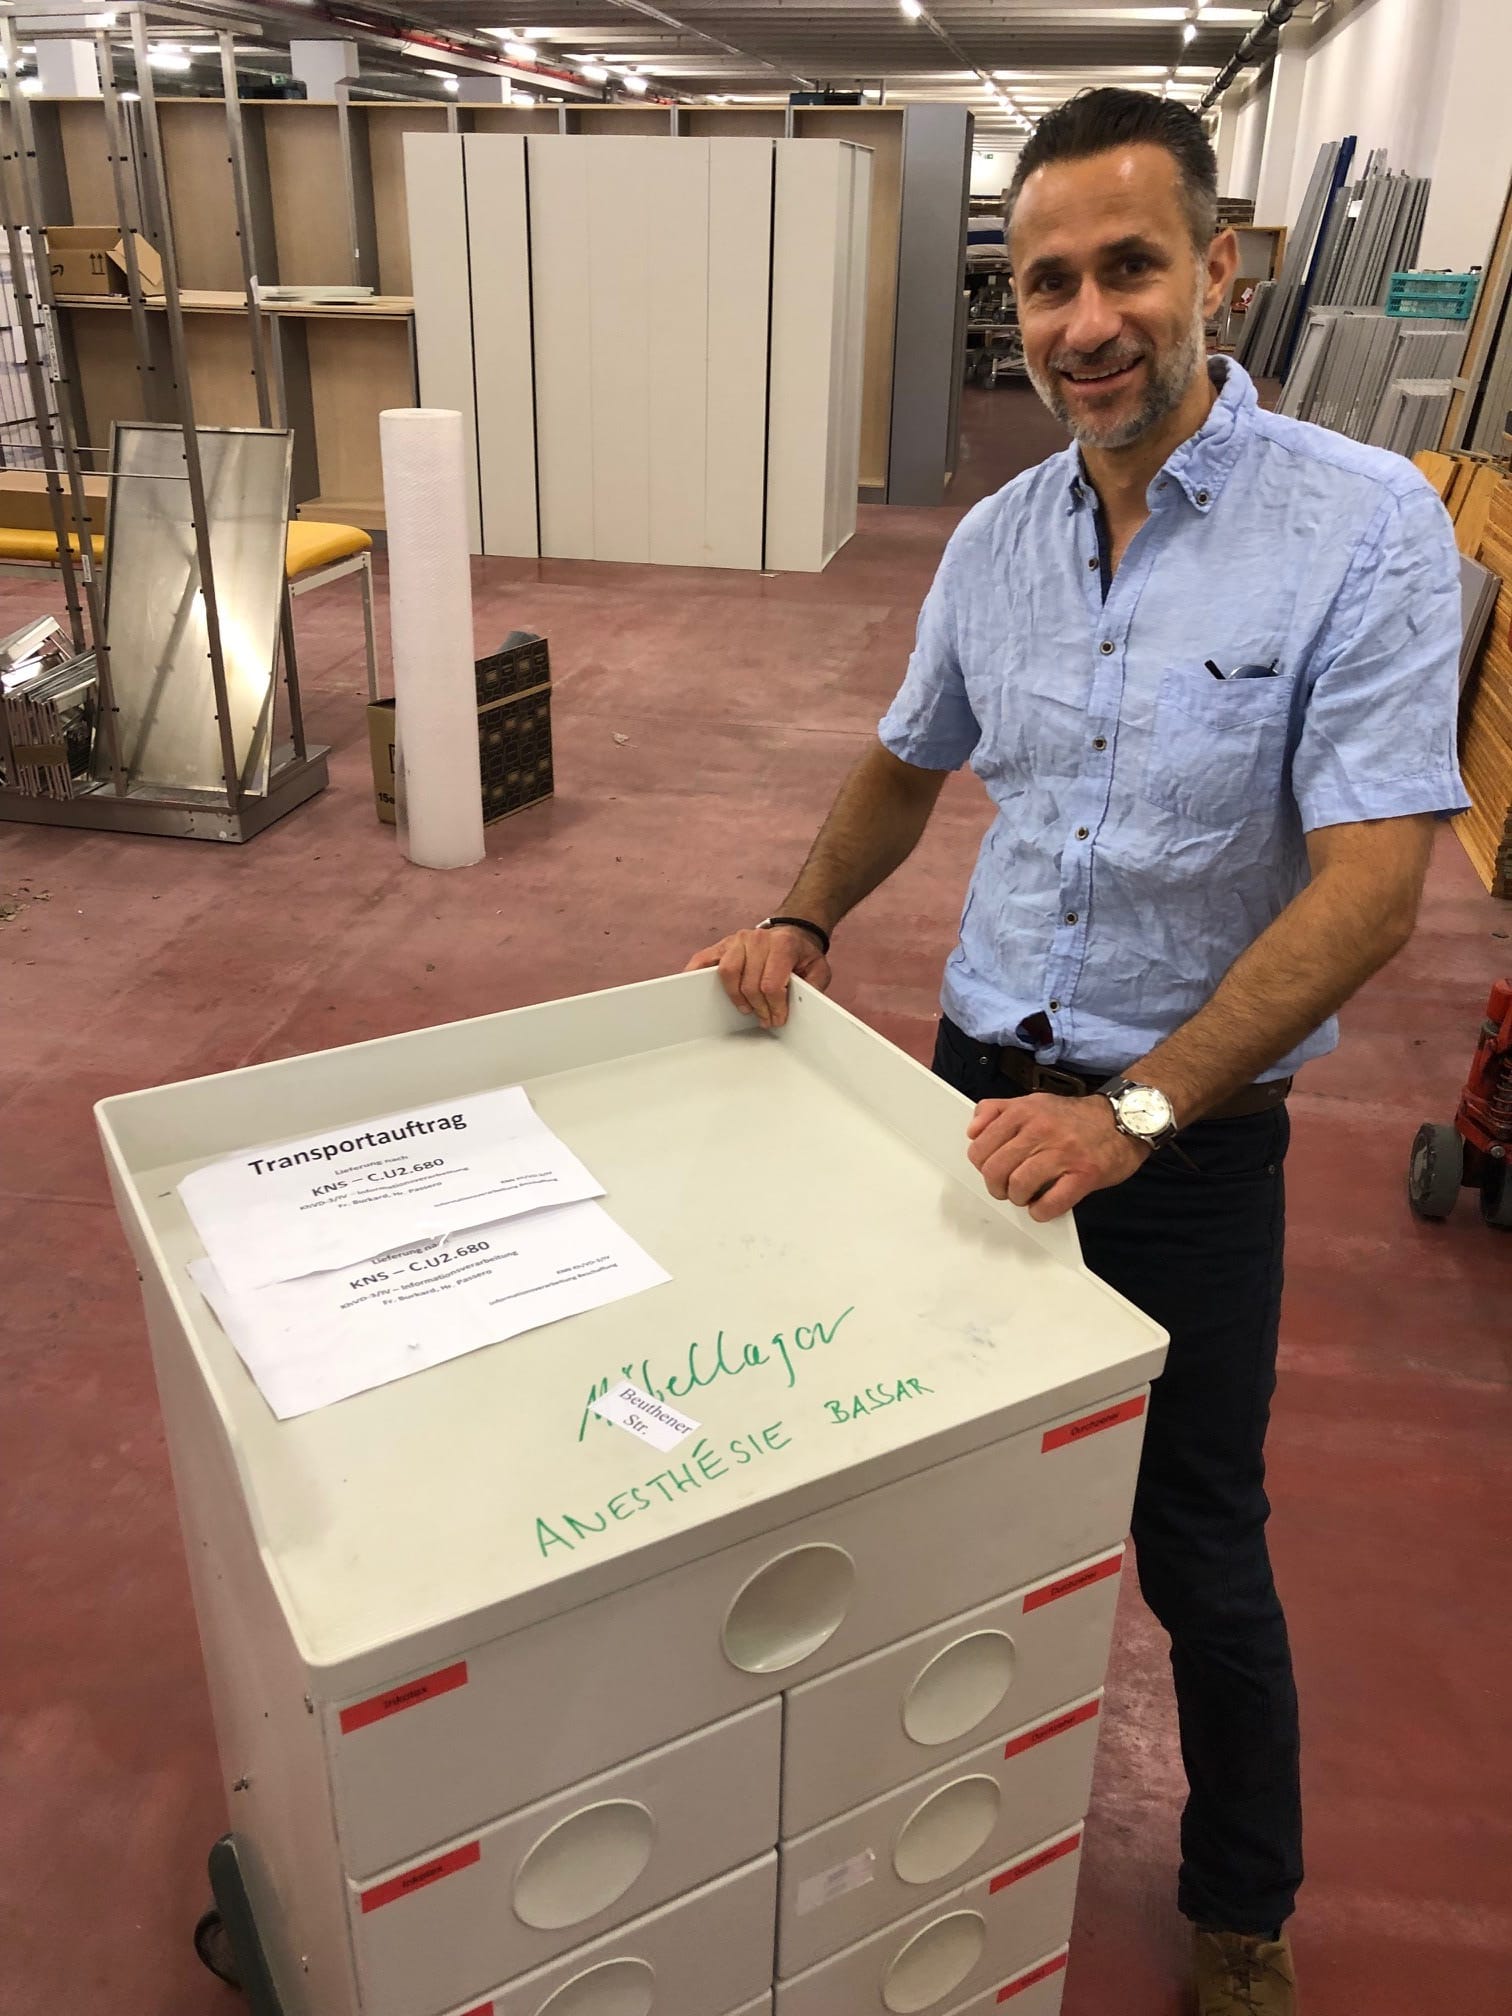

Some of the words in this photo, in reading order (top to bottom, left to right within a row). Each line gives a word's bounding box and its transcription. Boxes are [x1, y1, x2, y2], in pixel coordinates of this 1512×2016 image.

[247, 1113, 467, 1176] Transportauftrag
[312, 1180, 348, 1197] KNS
[367, 1158, 445, 1182] C.U2.680
[335, 1159, 383, 1176] Lieferung
[350, 1271, 389, 1290] KNS
[408, 1241, 490, 1272] C.U2.680
[371, 1248, 424, 1266] Lieferung
[401, 1250, 519, 1291] Informationsverarbeitung
[619, 1387, 693, 1435] Beuthener
[622, 1413, 649, 1435] Str.
[535, 1421, 793, 1558] ANESTHÉSIE
[824, 1376, 935, 1425] BASSAR
